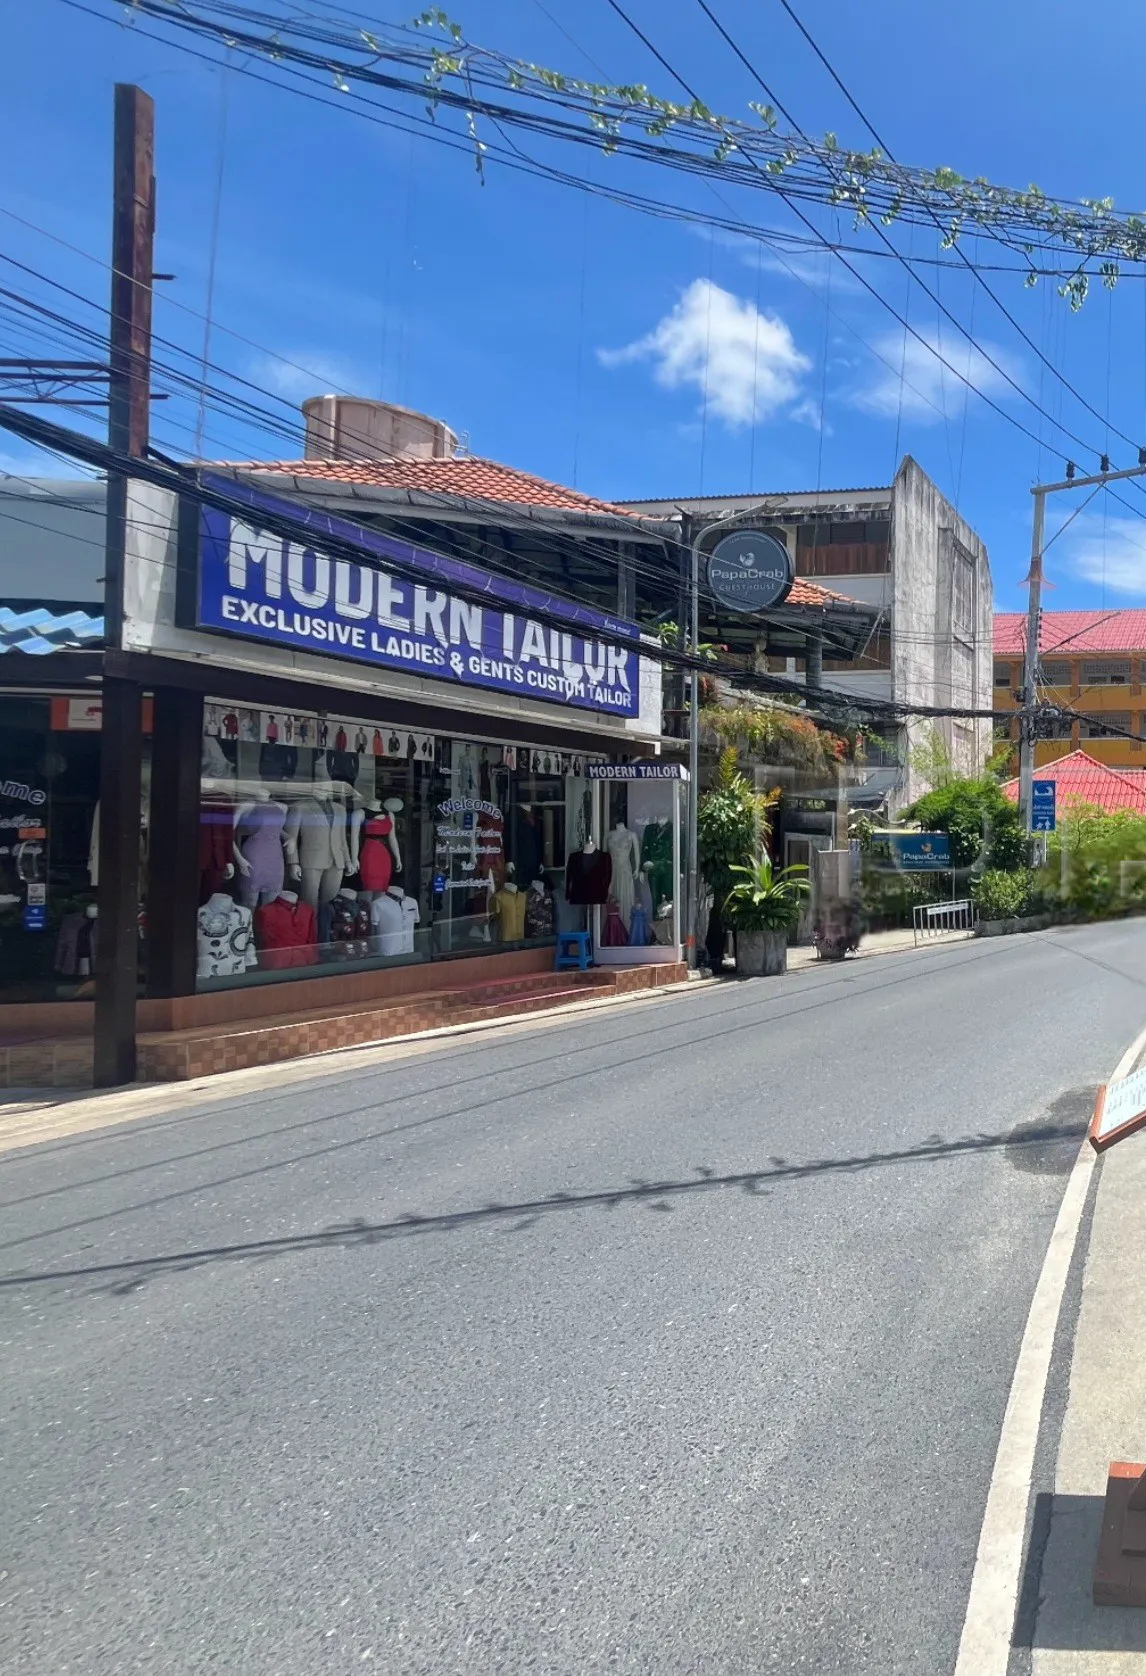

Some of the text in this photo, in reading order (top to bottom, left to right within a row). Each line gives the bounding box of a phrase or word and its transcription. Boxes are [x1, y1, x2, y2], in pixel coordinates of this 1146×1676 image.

[228, 514, 484, 650] MODERN
[711, 568, 784, 580] PapaCrab
[222, 594, 632, 708] EXCLUSIVE LADIES & GENTS CUSTOM TAILOR
[589, 766, 679, 778] MODERN TAILOR
[437, 796, 501, 819] Welcome
[903, 852, 950, 861] PapaCrab
